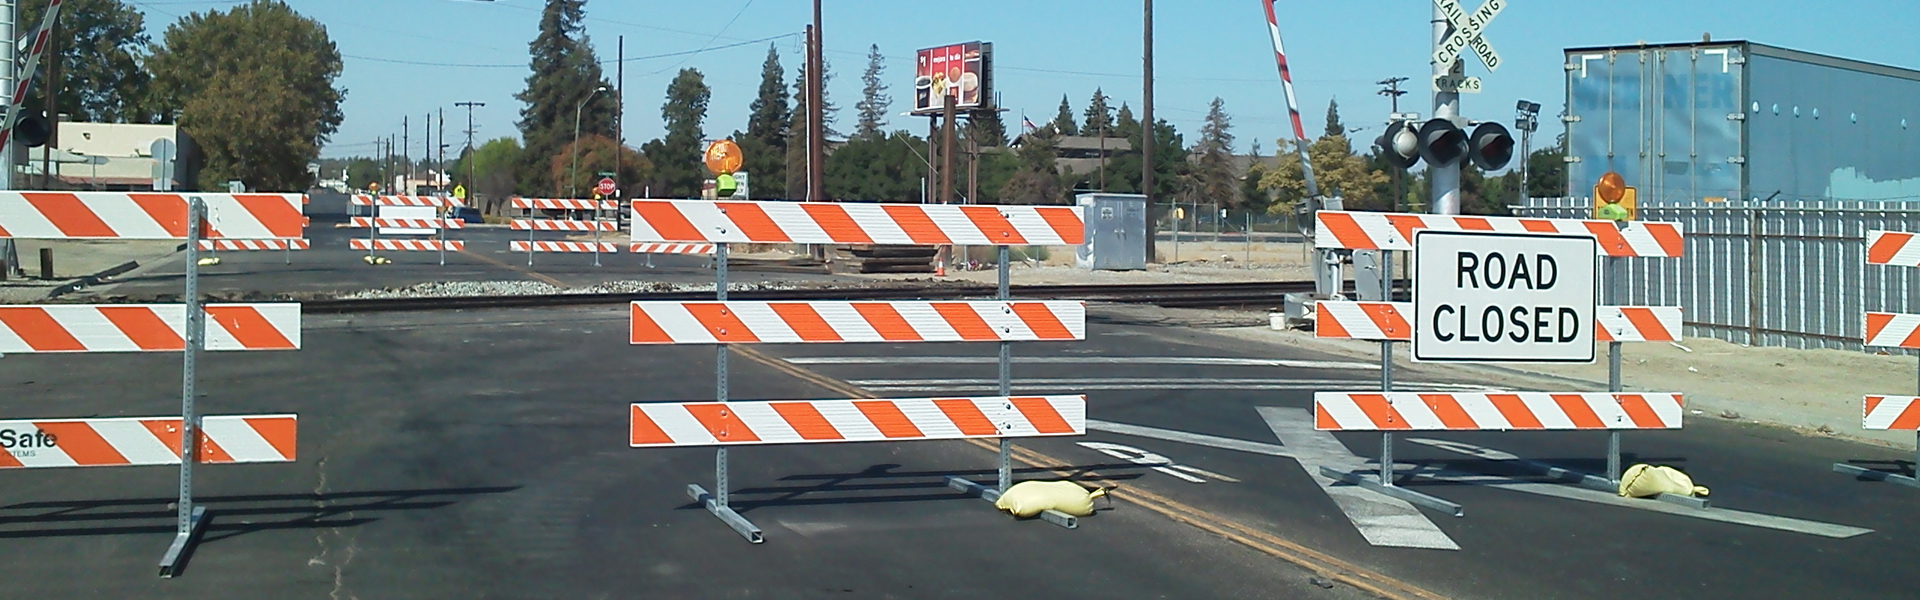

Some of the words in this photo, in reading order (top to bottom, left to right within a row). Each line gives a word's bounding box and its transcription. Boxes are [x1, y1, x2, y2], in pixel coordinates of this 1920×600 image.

[1438, 0, 1500, 64] CROSSING
[1453, 60, 1460, 74] 2
[1473, 36, 1498, 68] ROAD
[1435, 78, 1480, 90] TRACKS
[1457, 251, 1557, 290] ROAD
[1433, 304, 1579, 343] CLOSED
[0, 428, 57, 448] Safe
